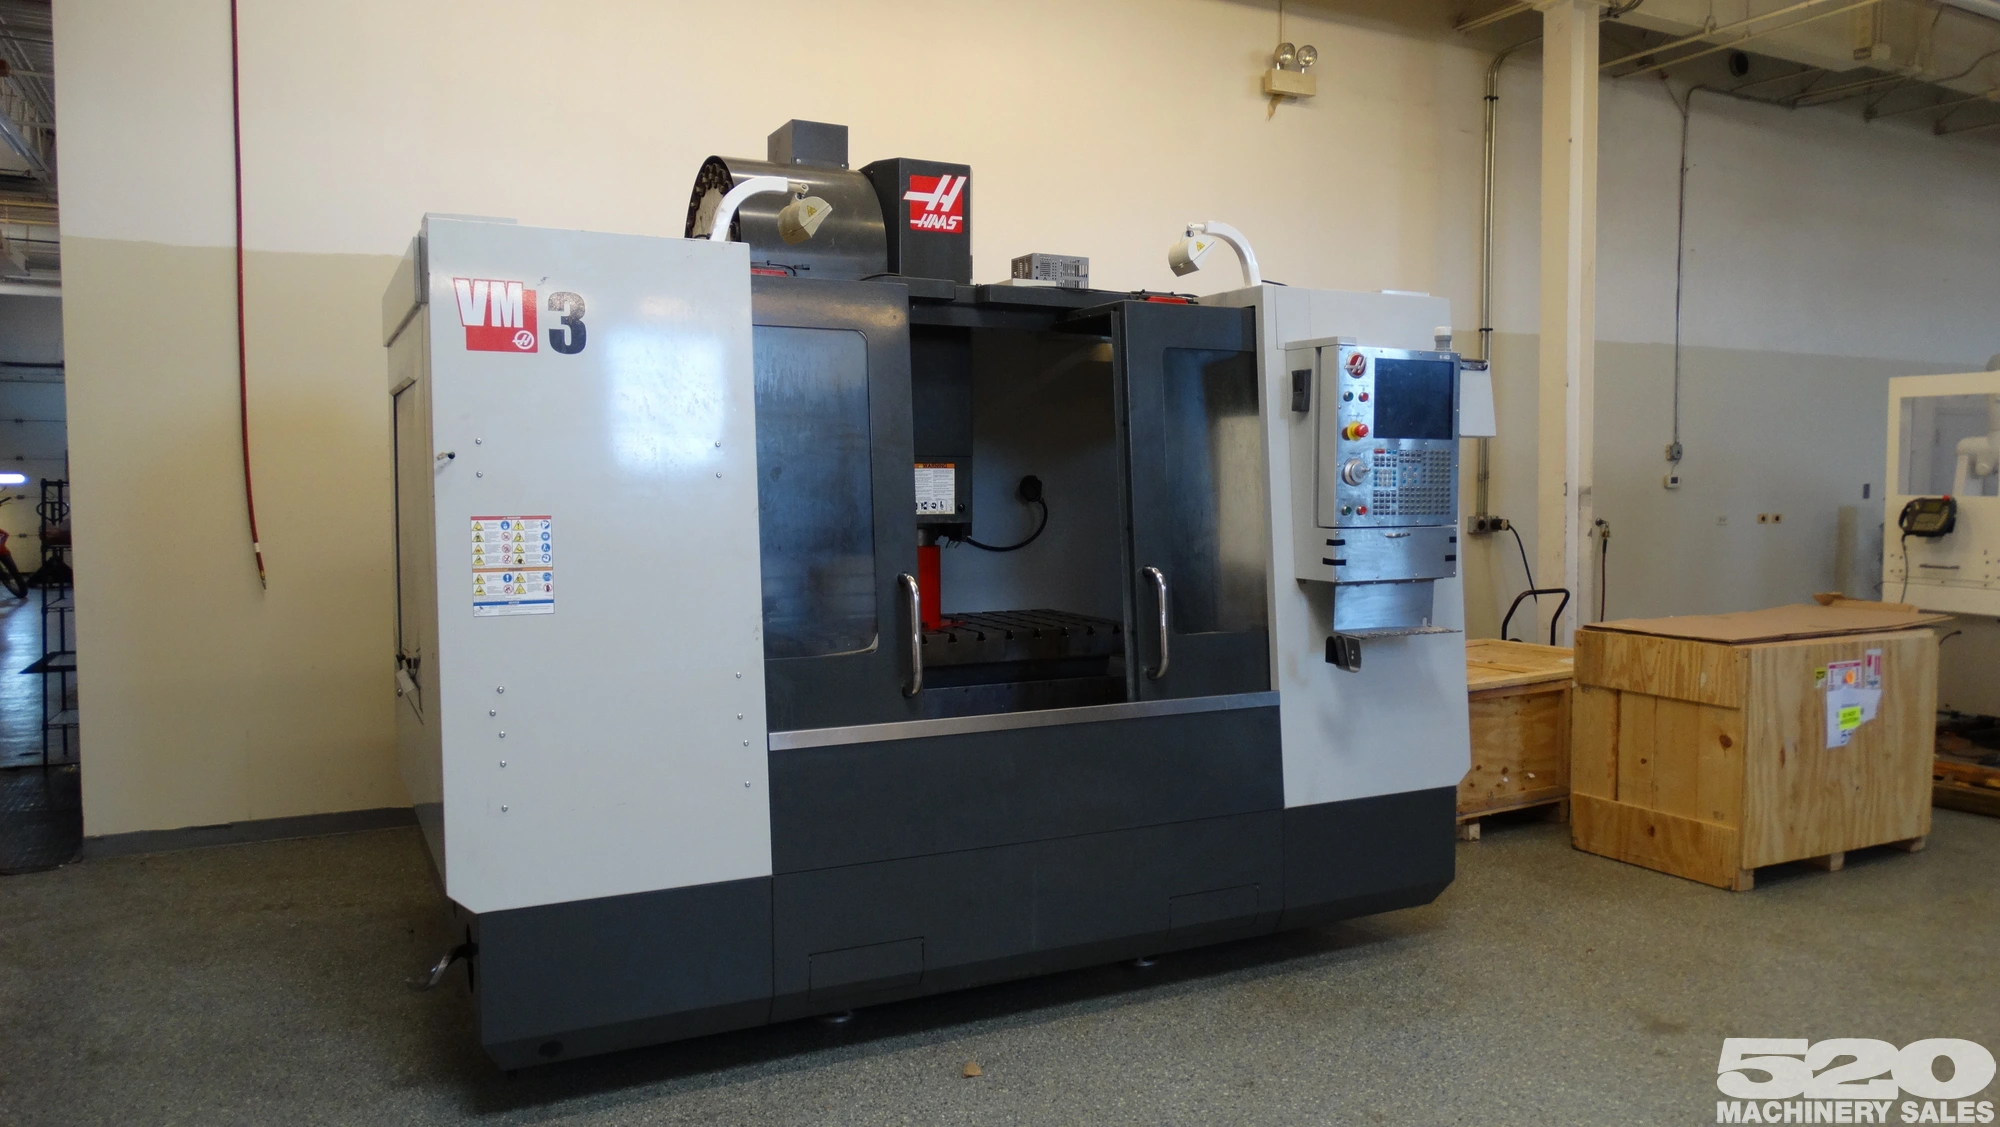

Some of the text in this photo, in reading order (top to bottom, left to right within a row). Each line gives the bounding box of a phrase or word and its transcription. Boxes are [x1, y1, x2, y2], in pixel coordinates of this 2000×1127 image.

[910, 213, 963, 230] HAAS
[453, 278, 587, 355] VM 3
